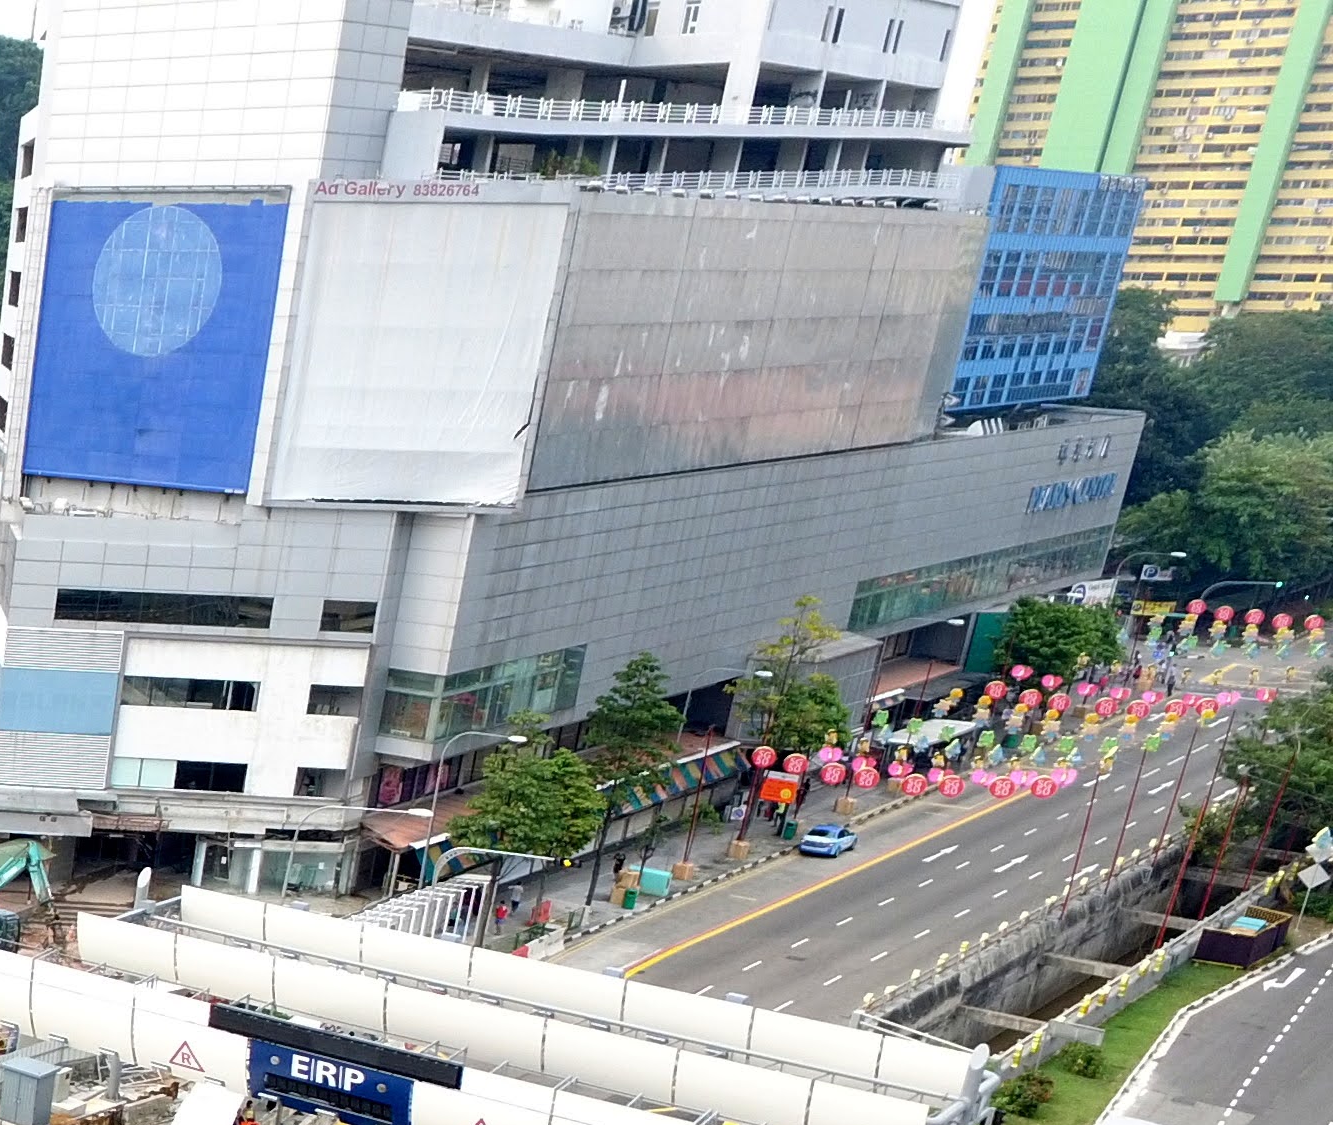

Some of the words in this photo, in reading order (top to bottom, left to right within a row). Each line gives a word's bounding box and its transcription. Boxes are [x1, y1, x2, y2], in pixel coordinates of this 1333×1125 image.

[344, 181, 406, 198] Gallery
[413, 184, 480, 197] 83826764
[181, 1051, 192, 1066] R
